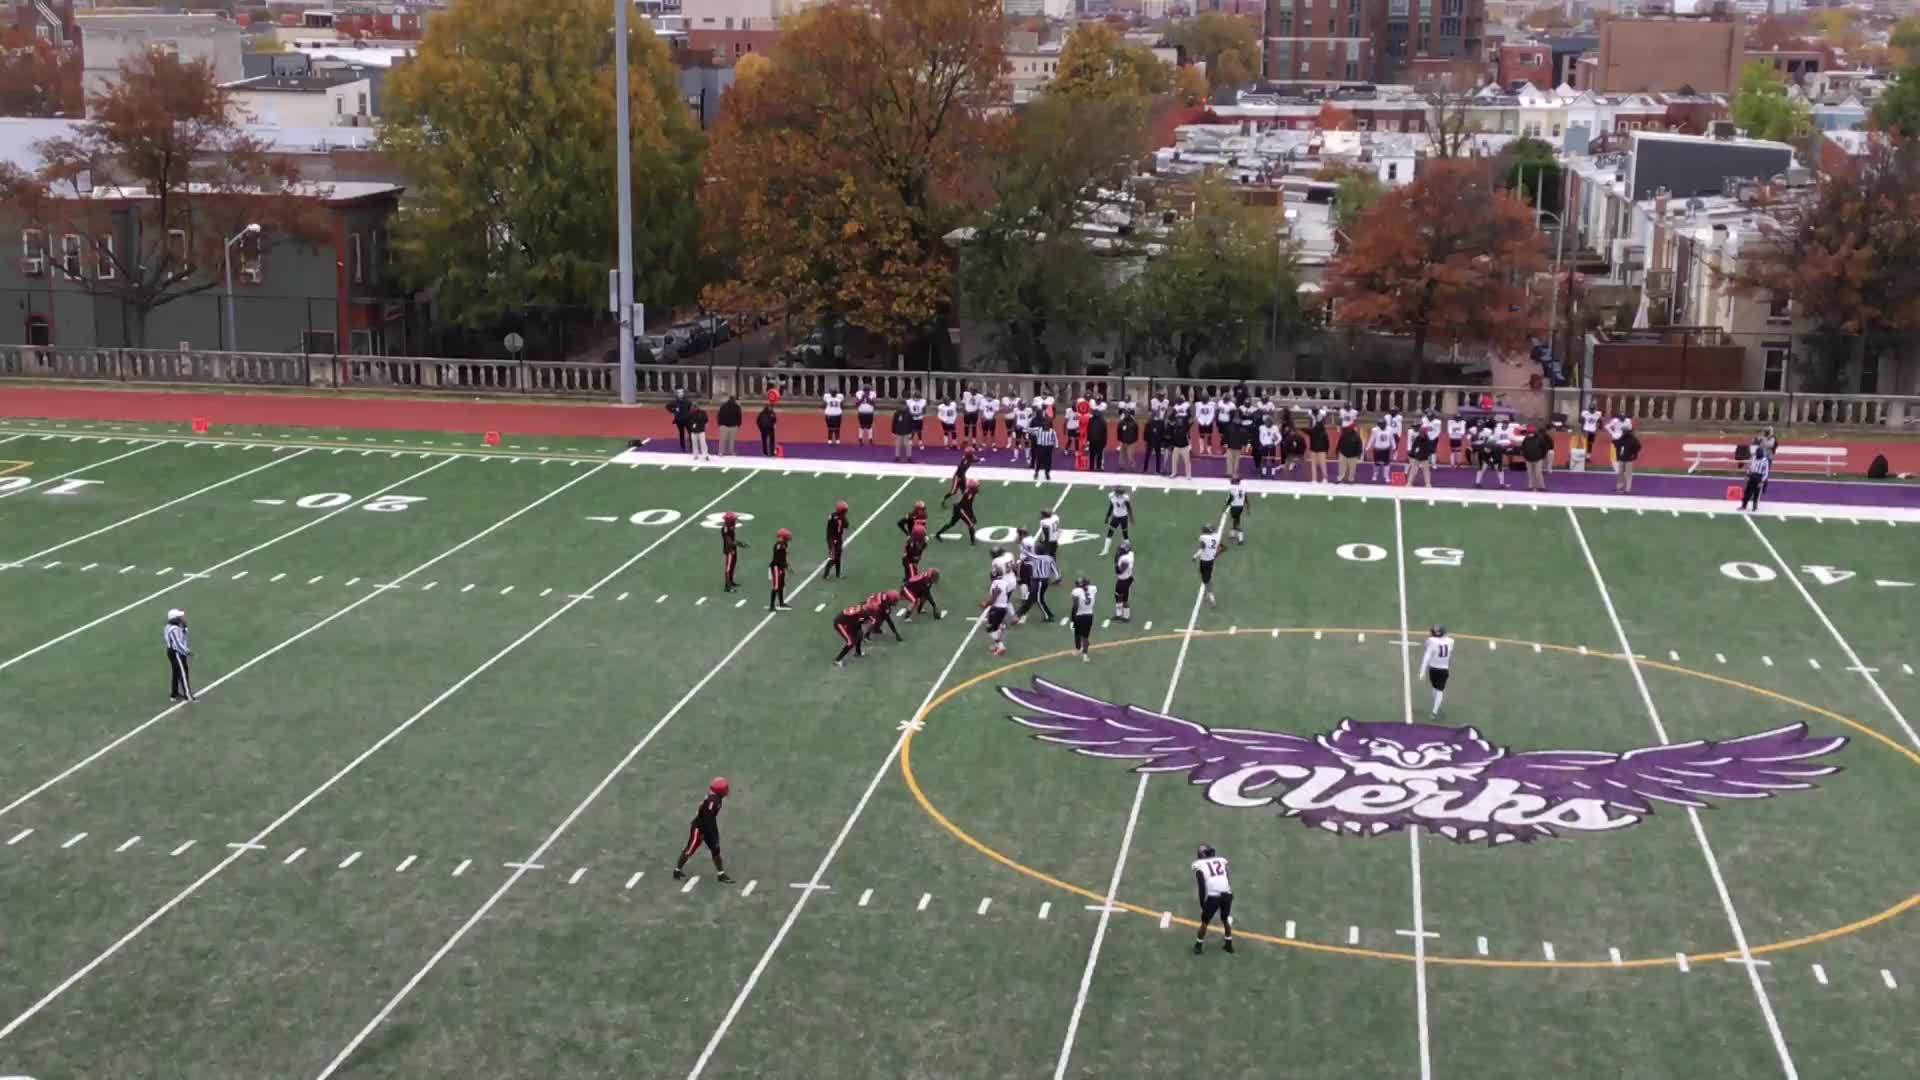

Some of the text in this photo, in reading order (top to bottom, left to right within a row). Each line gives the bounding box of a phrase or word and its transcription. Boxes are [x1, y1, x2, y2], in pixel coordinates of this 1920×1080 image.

[1336, 543, 1465, 567] 50
[1719, 561, 1857, 585] 40
[1439, 644, 1449, 658] 11
[1208, 764, 1641, 831] Clerks
[1206, 860, 1225, 877] 12
